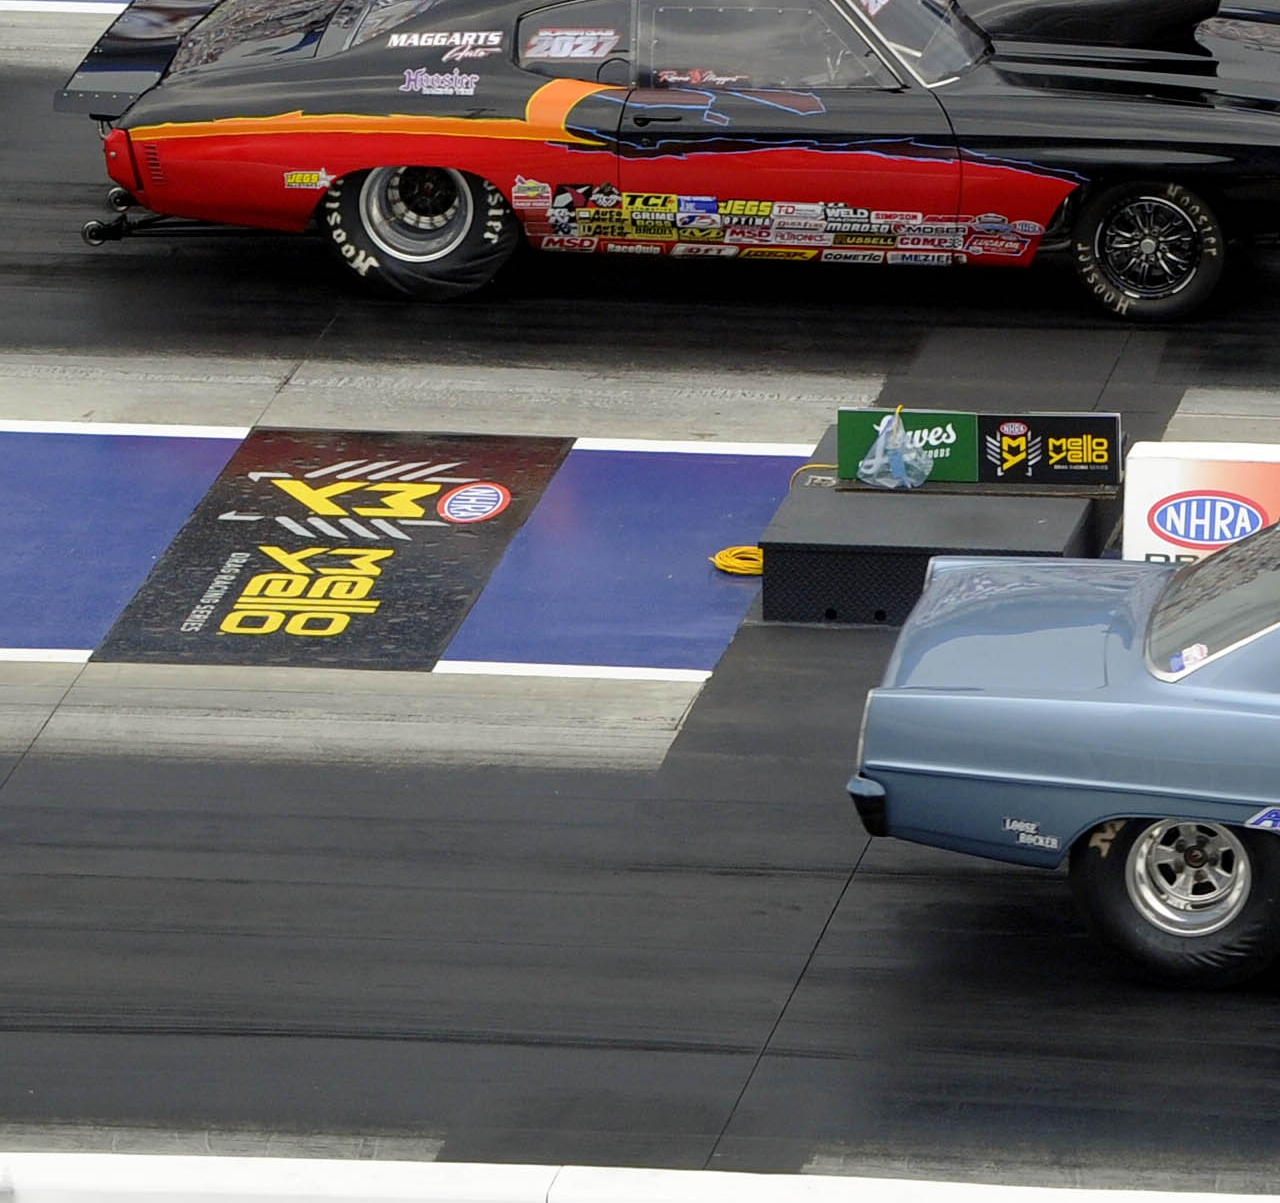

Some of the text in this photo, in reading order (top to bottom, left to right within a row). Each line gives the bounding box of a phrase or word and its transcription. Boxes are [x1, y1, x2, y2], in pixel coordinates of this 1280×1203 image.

[388, 31, 503, 47] MAGGARTS
[526, 36, 620, 58] 2027
[442, 46, 502, 62] Auto
[399, 68, 480, 92] Hoosier
[287, 173, 319, 184] JEGS
[625, 195, 669, 207] TCI
[718, 200, 772, 216] JEGS
[827, 208, 869, 218] WELD
[632, 212, 675, 220] GRIME
[875, 213, 918, 221] SIMPSON
[827, 223, 889, 233] MOROSO
[730, 230, 771, 238] MSD
[551, 238, 595, 247] MSD
[900, 238, 947, 247] COMP
[824, 253, 881, 261] COMETIC
[1002, 424, 1028, 434] NHRA
[1166, 501, 1251, 539] NHRA
[200, 574, 236, 604] RACING
[180, 604, 215, 632] SERIES
